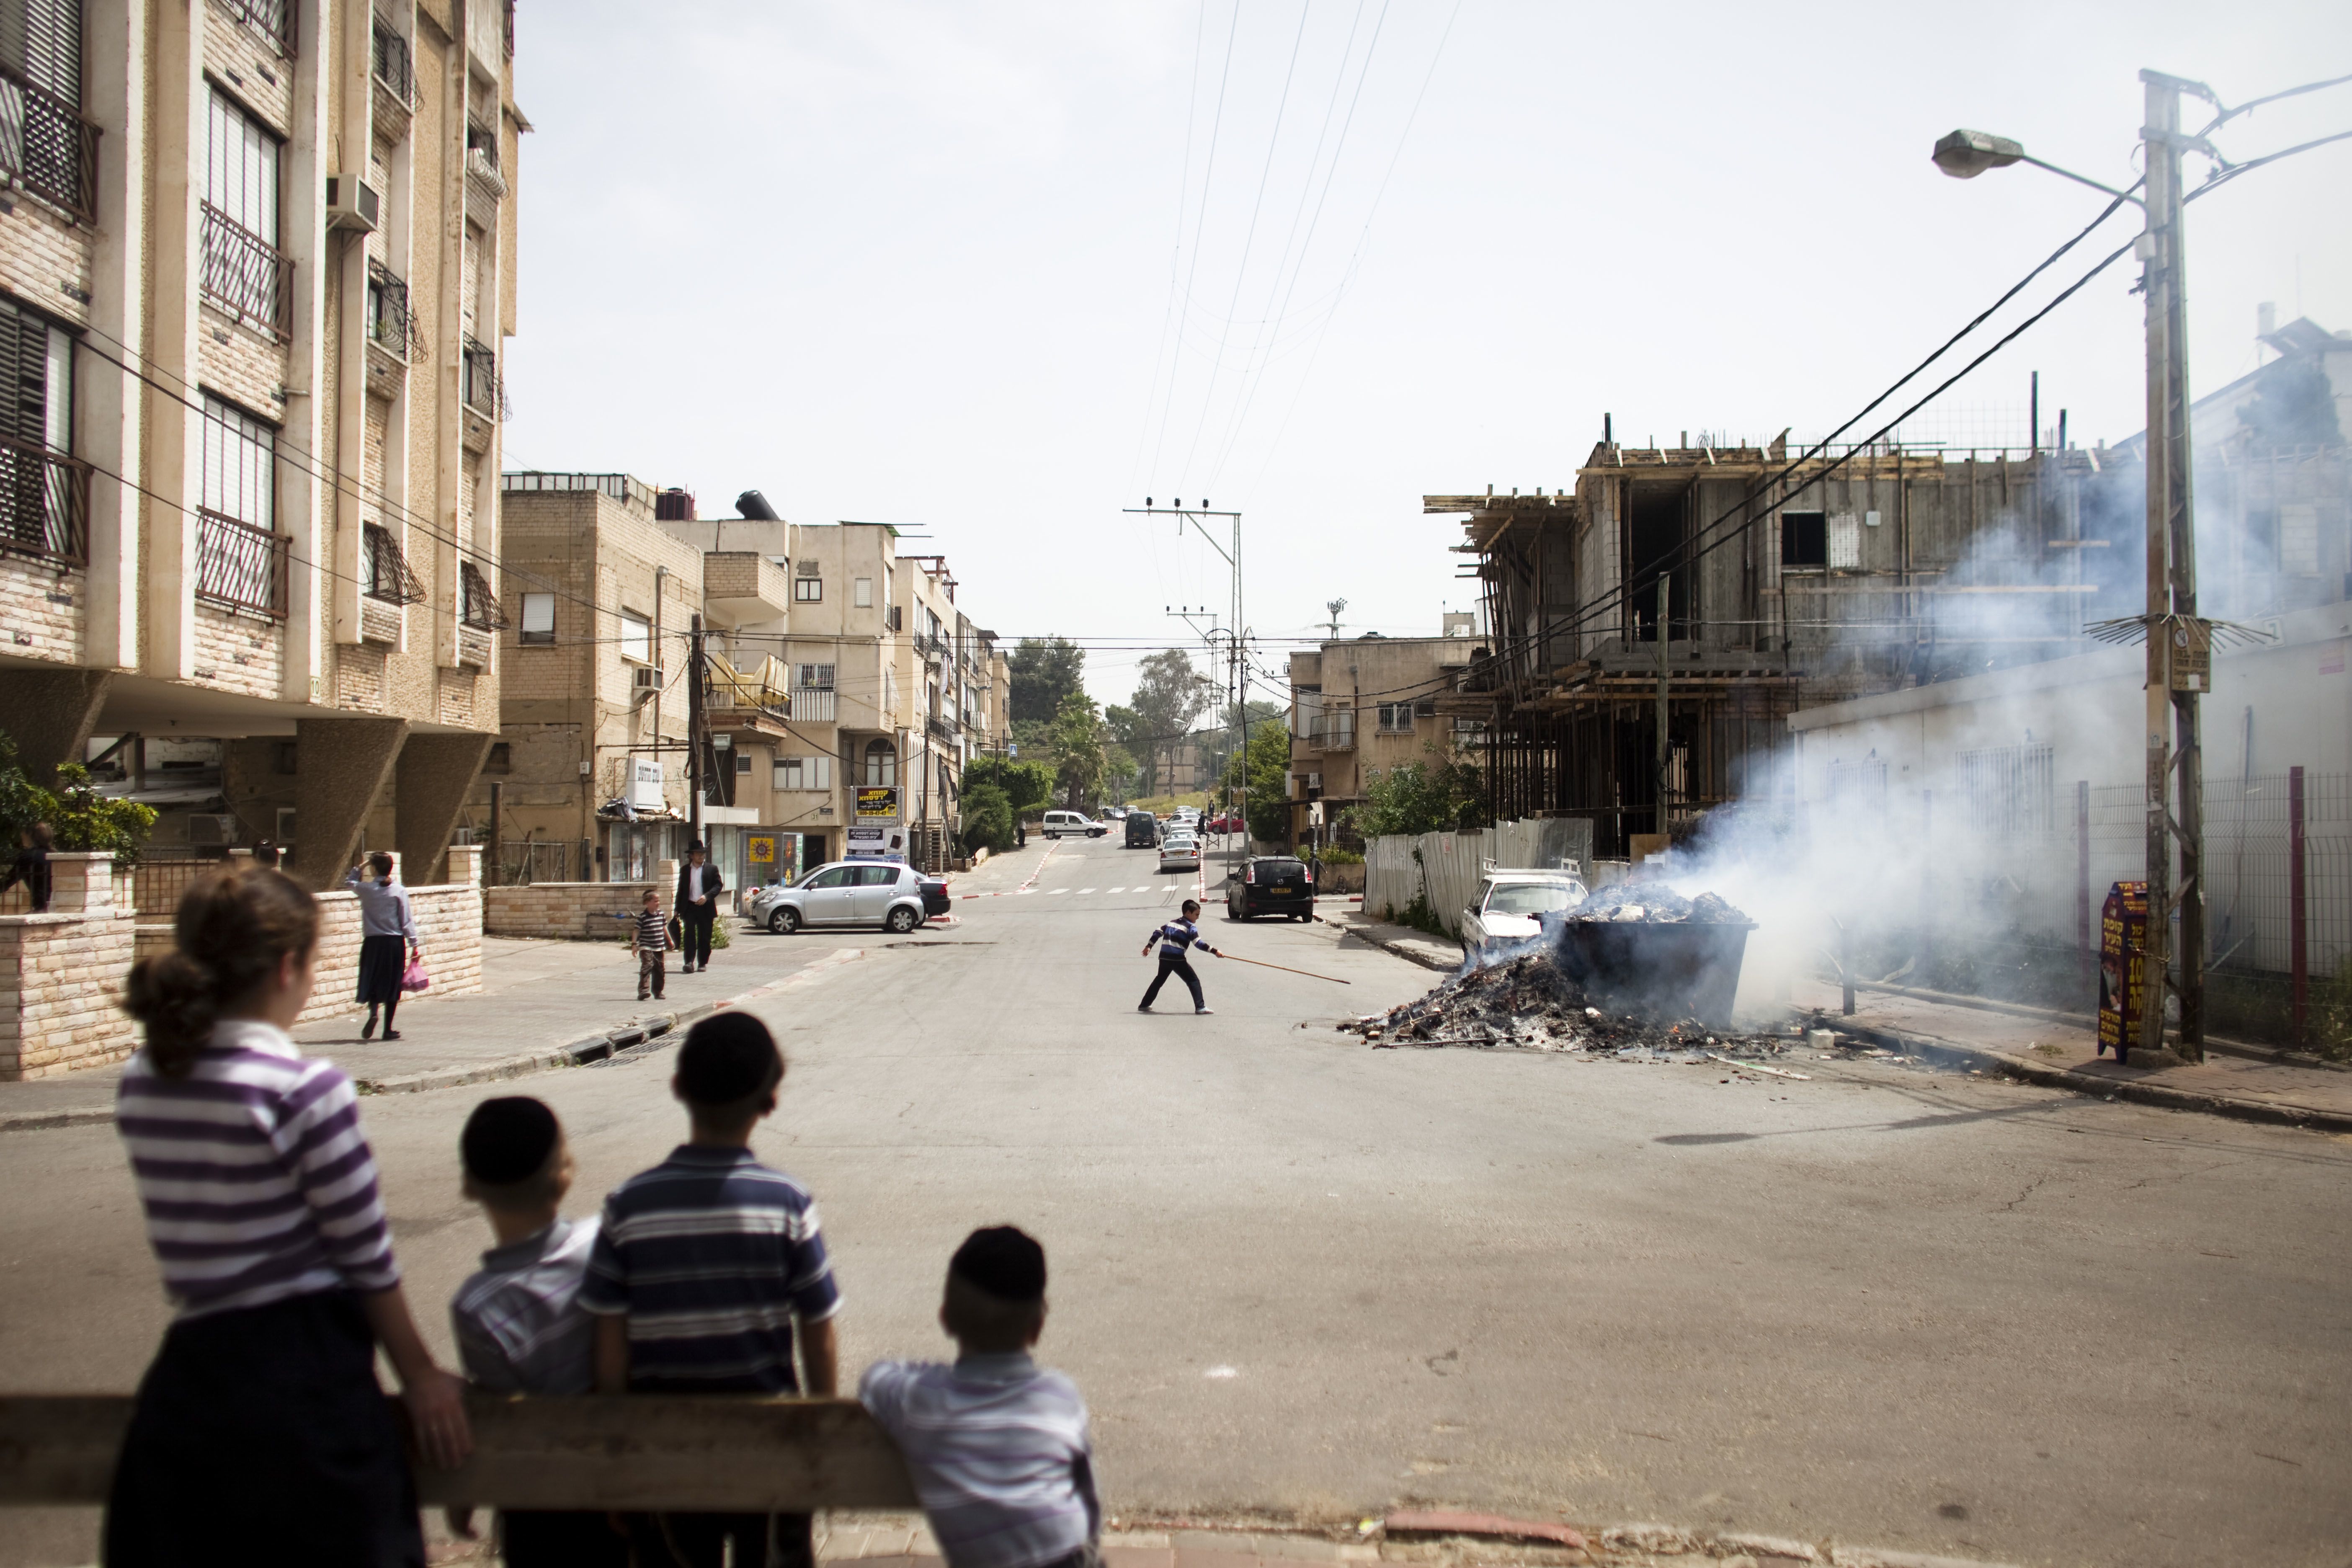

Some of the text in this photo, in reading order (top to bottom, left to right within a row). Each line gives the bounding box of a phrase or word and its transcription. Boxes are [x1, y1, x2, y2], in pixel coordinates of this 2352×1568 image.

[311, 680, 319, 694] 10
[2104, 918, 2123, 935] קופת
[2104, 932, 2122, 946] העיר
